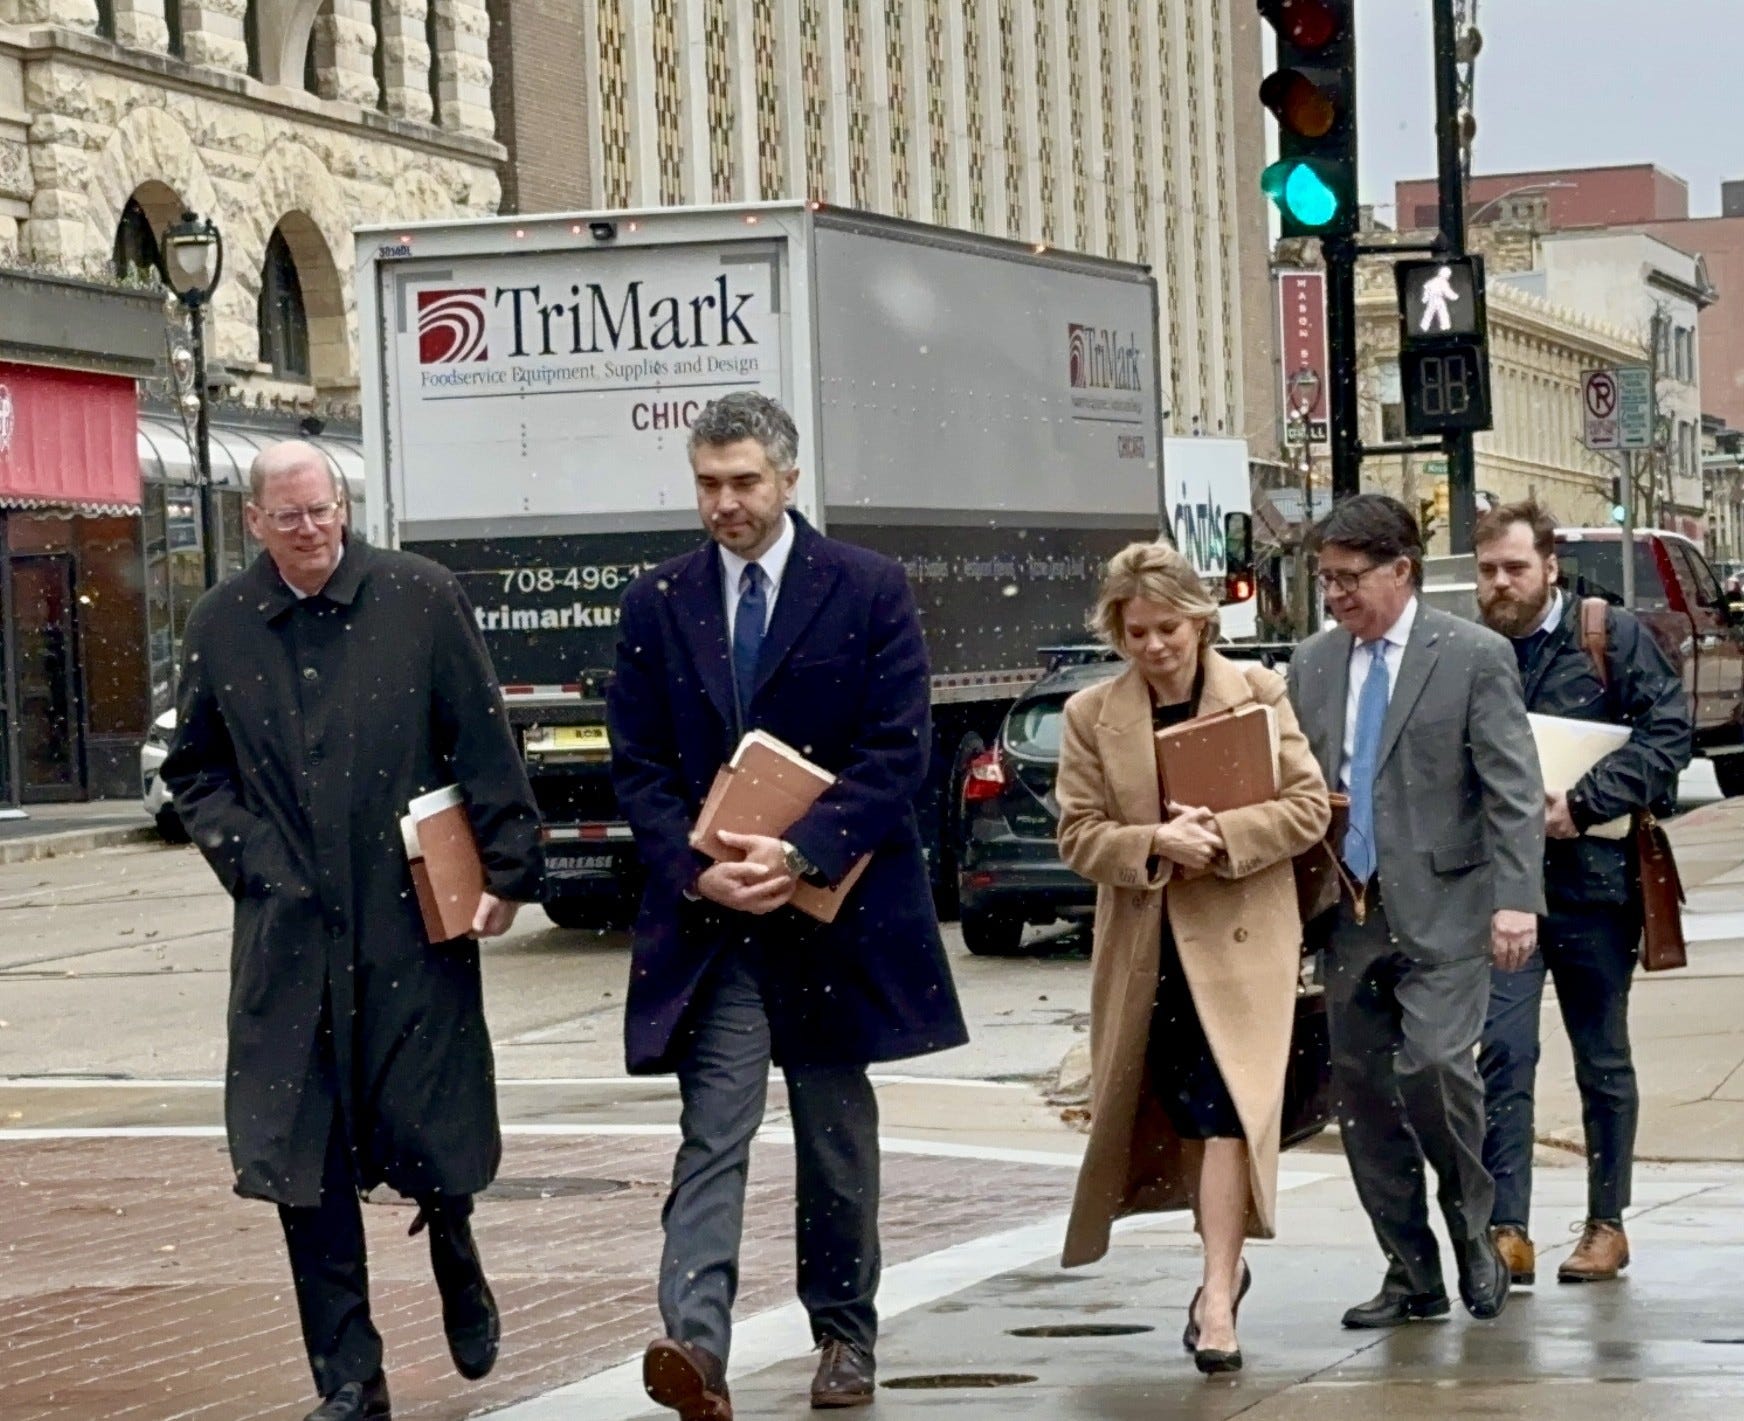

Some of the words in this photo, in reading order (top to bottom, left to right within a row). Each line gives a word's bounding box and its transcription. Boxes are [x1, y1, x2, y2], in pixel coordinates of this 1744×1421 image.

[495, 273, 758, 358] TriMark
[421, 370, 507, 387] Foodservice
[604, 360, 669, 379] Supplies
[673, 358, 703, 376] and
[707, 356, 759, 377] Design
[499, 562, 657, 593] 708-496-1
